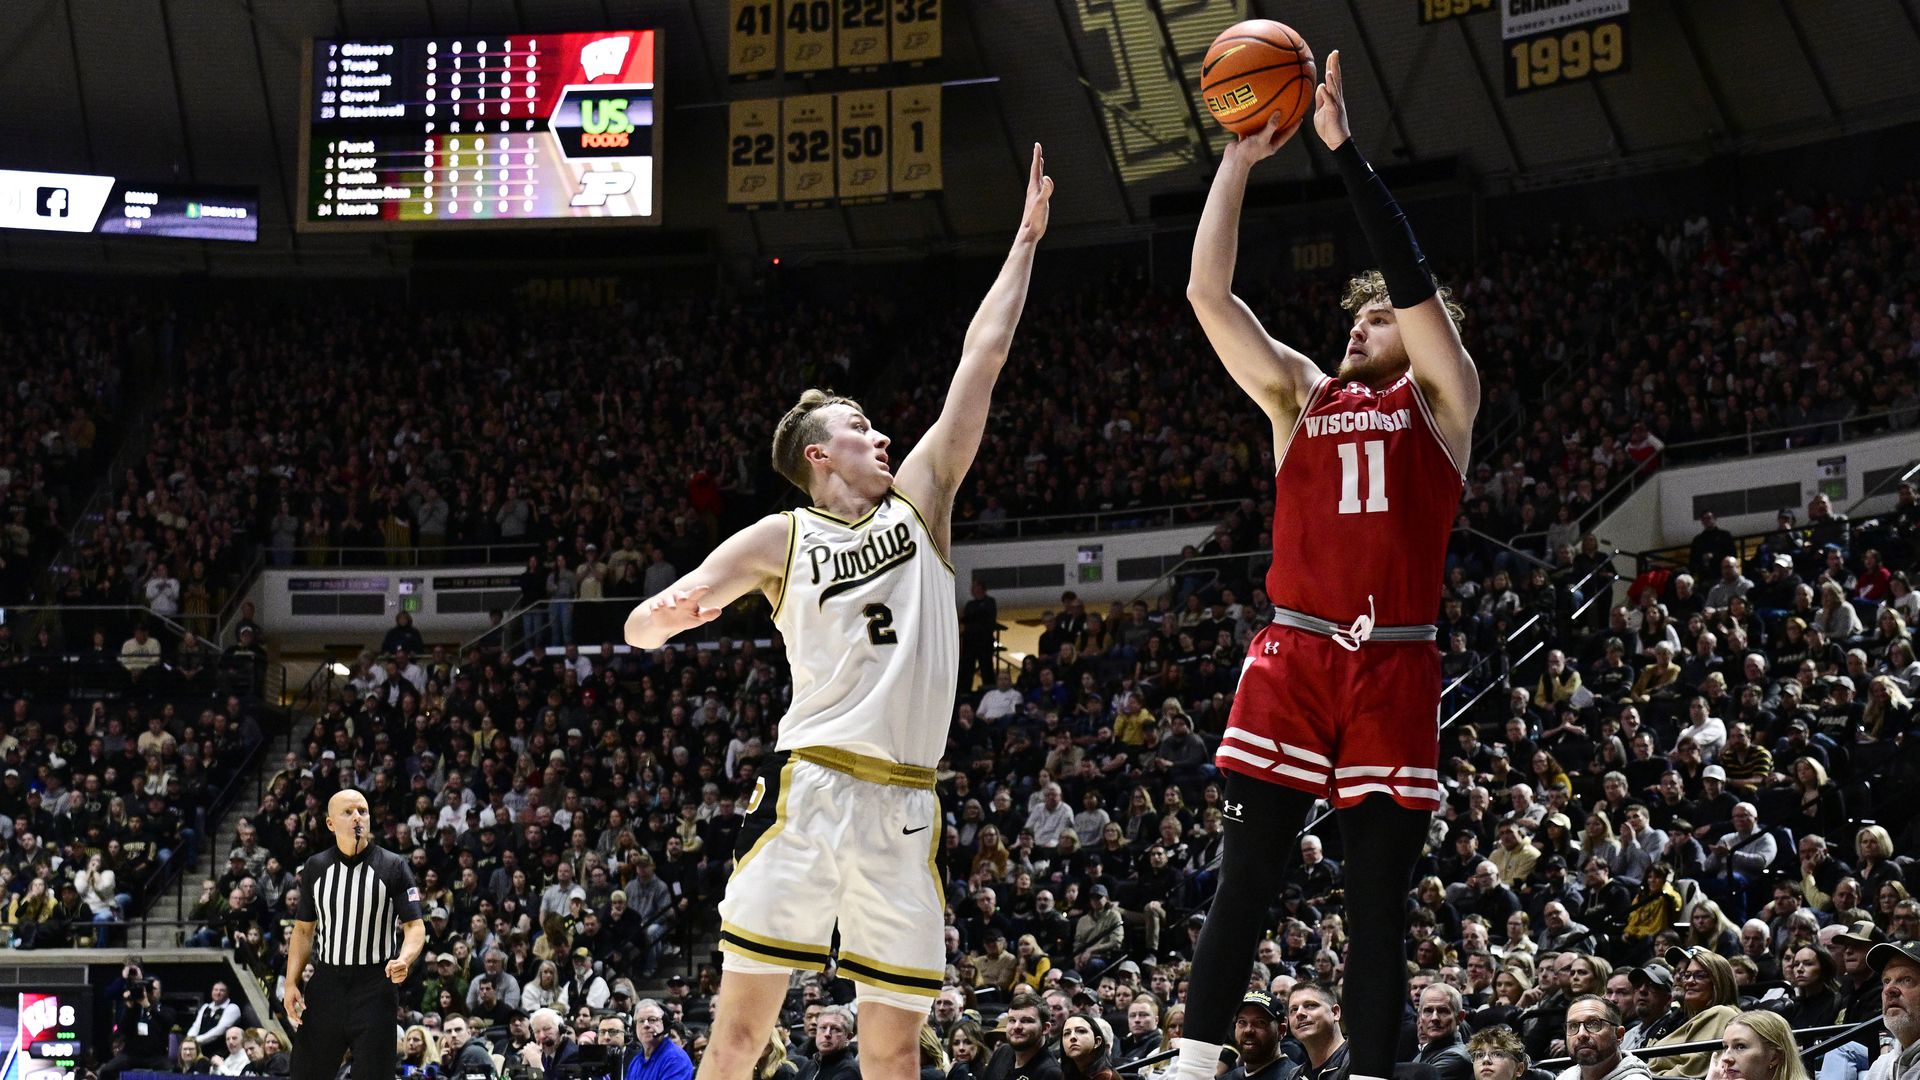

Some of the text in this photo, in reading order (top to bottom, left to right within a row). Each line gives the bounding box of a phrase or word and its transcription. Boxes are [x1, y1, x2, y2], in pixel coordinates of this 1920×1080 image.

[736, 5, 771, 36] 41
[787, 1, 829, 34] 40
[841, 0, 884, 29] 22
[896, 0, 937, 24] 32
[330, 45, 337, 56] 7
[1511, 23, 1623, 90] 1999
[328, 61, 336, 72] 9
[326, 76, 337, 87] 11
[322, 91, 335, 103] 22
[476, 121, 484, 132] A
[582, 133, 630, 148] FOODS
[911, 120, 923, 153] 1
[329, 142, 334, 153] 1
[732, 133, 775, 167] 22
[787, 129, 830, 164] 32
[842, 125, 883, 160] 50
[324, 189, 332, 200] 4
[1305, 408, 1413, 438] WISCONSIN
[1337, 440, 1389, 514] 11
[807, 522, 917, 590] Purdue
[863, 602, 898, 645] 2
[59, 1006, 75, 1026] 8
